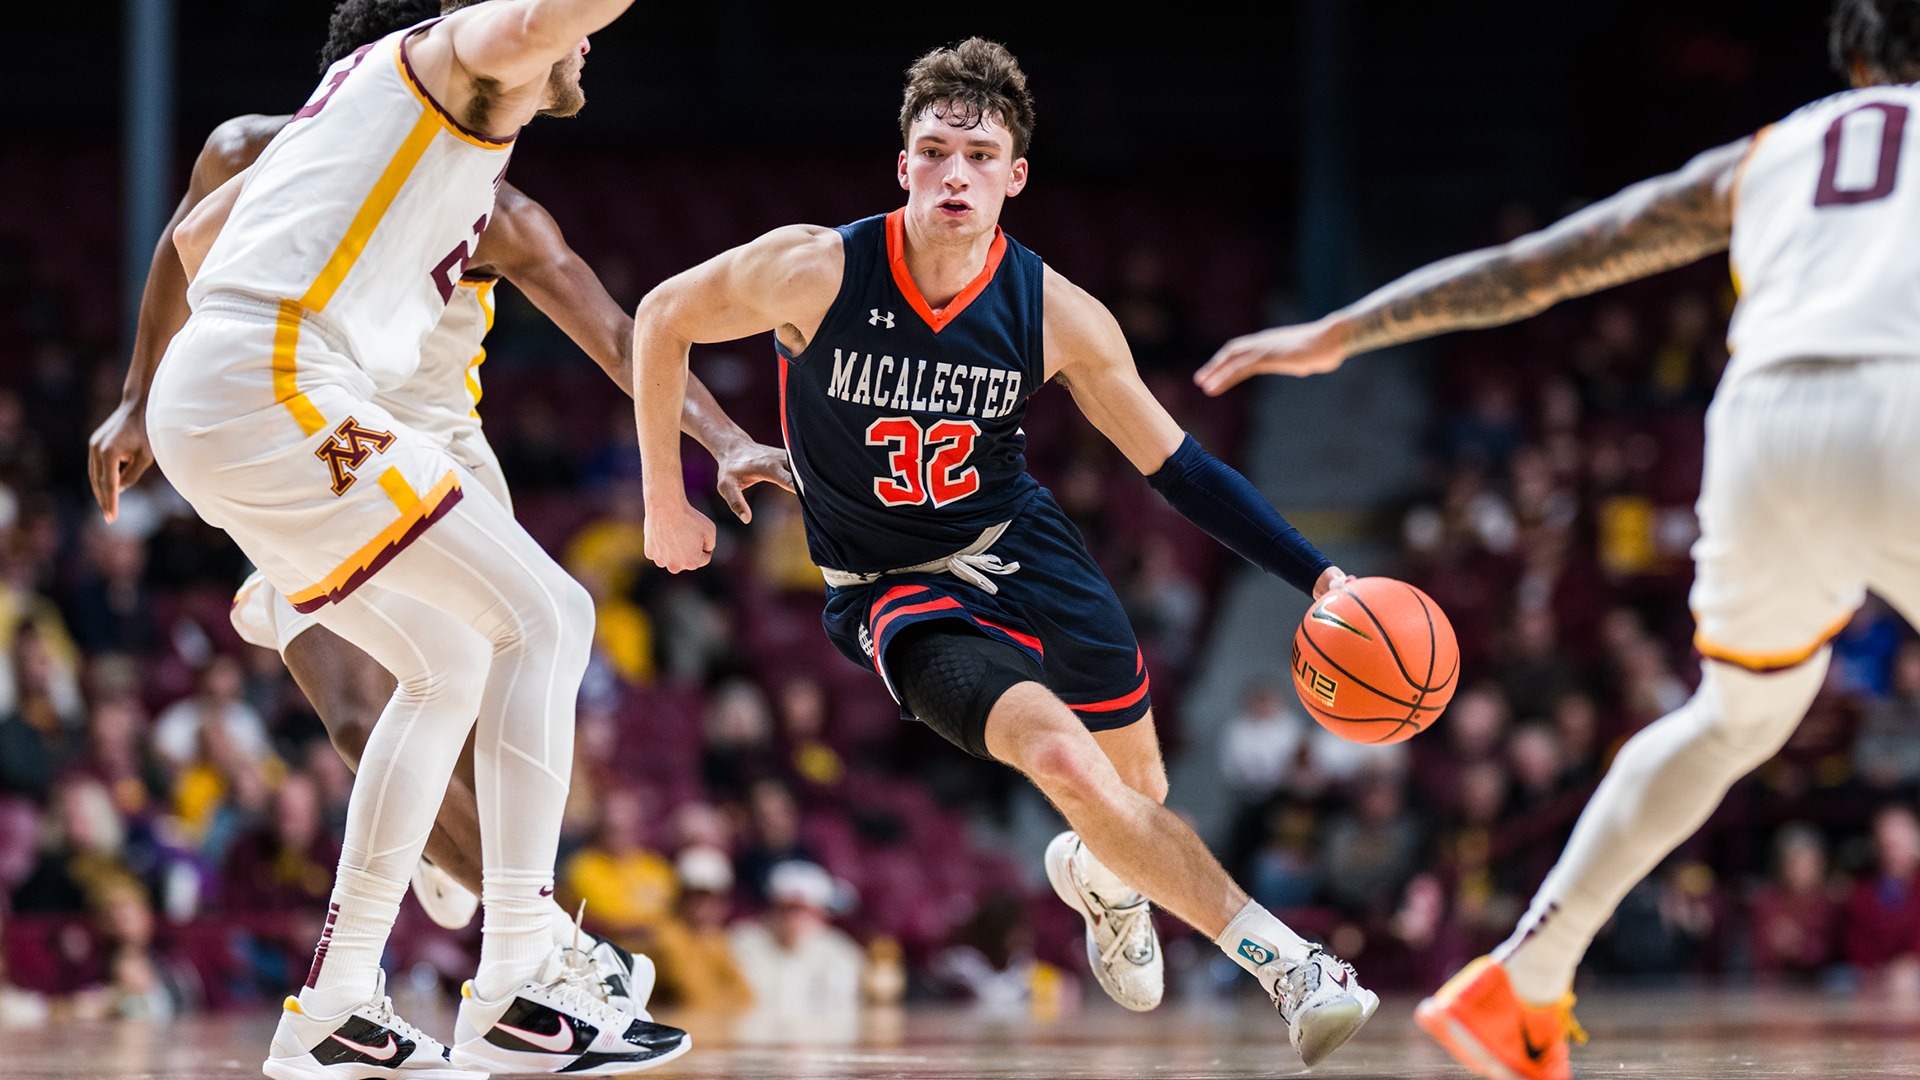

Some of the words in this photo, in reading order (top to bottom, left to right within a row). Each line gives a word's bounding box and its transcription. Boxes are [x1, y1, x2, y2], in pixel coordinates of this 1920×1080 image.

[1812, 102, 1909, 208] 0
[827, 348, 1022, 418] MACALESTER
[314, 415, 397, 497] M
[865, 416, 982, 509] 32
